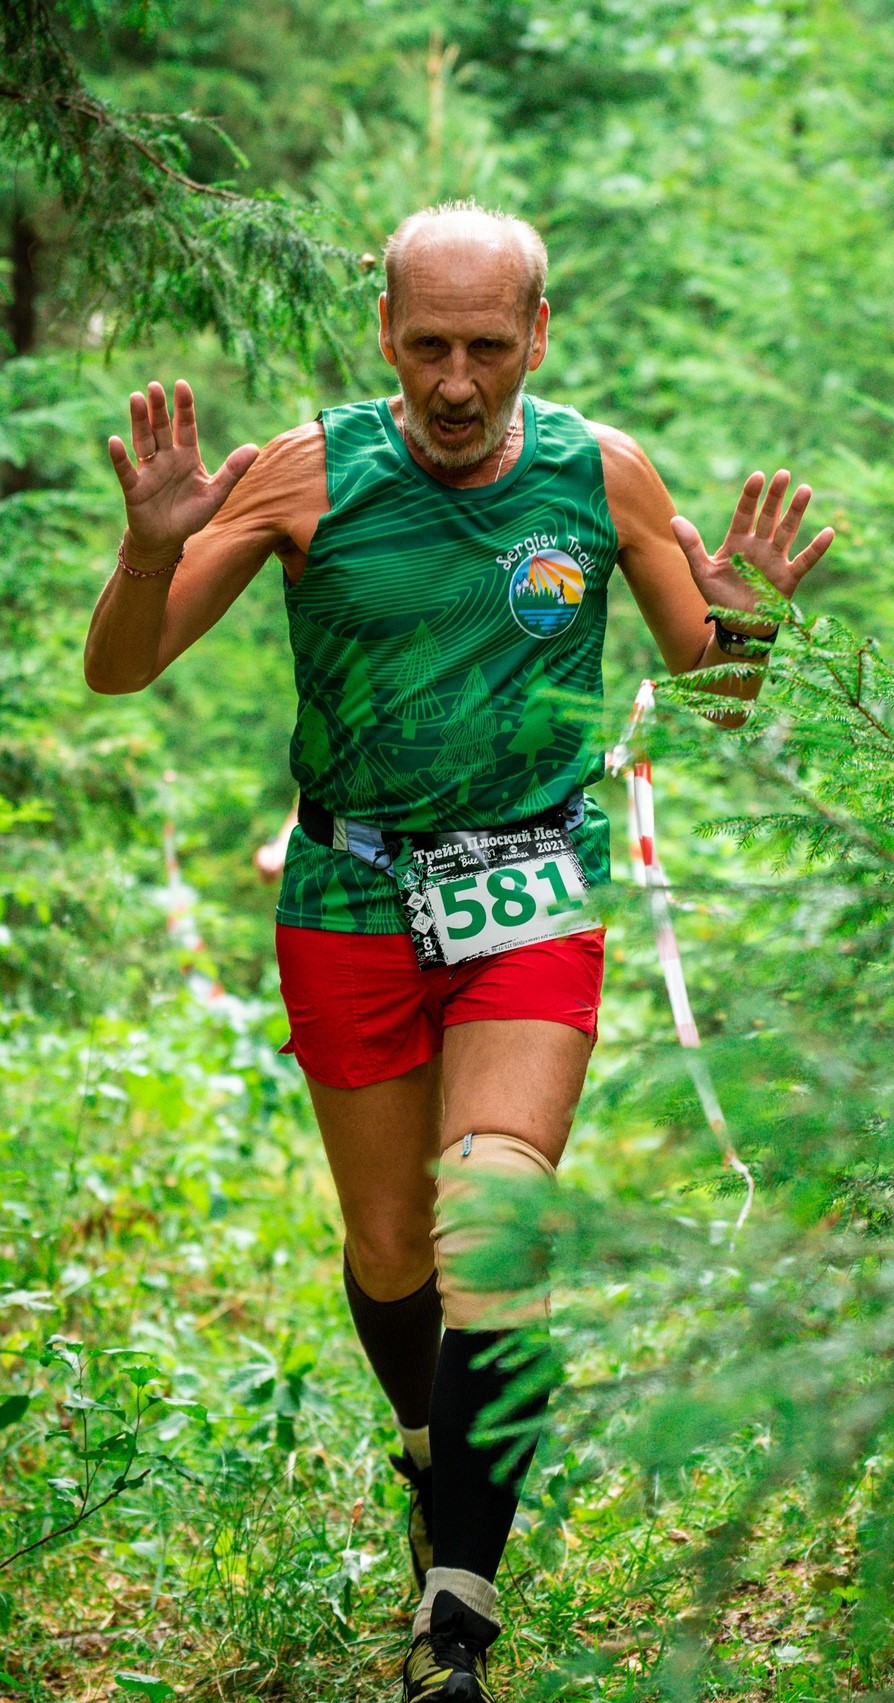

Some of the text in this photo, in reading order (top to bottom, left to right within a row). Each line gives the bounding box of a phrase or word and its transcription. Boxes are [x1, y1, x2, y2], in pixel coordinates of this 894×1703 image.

[496, 532, 596, 574] Sergiev Trail
[412, 826, 561, 865] Трейл Плоский Лес
[535, 839, 567, 854] 2021
[426, 861, 456, 874] Арена
[438, 861, 584, 940] 581
[423, 936, 433, 950] 8
